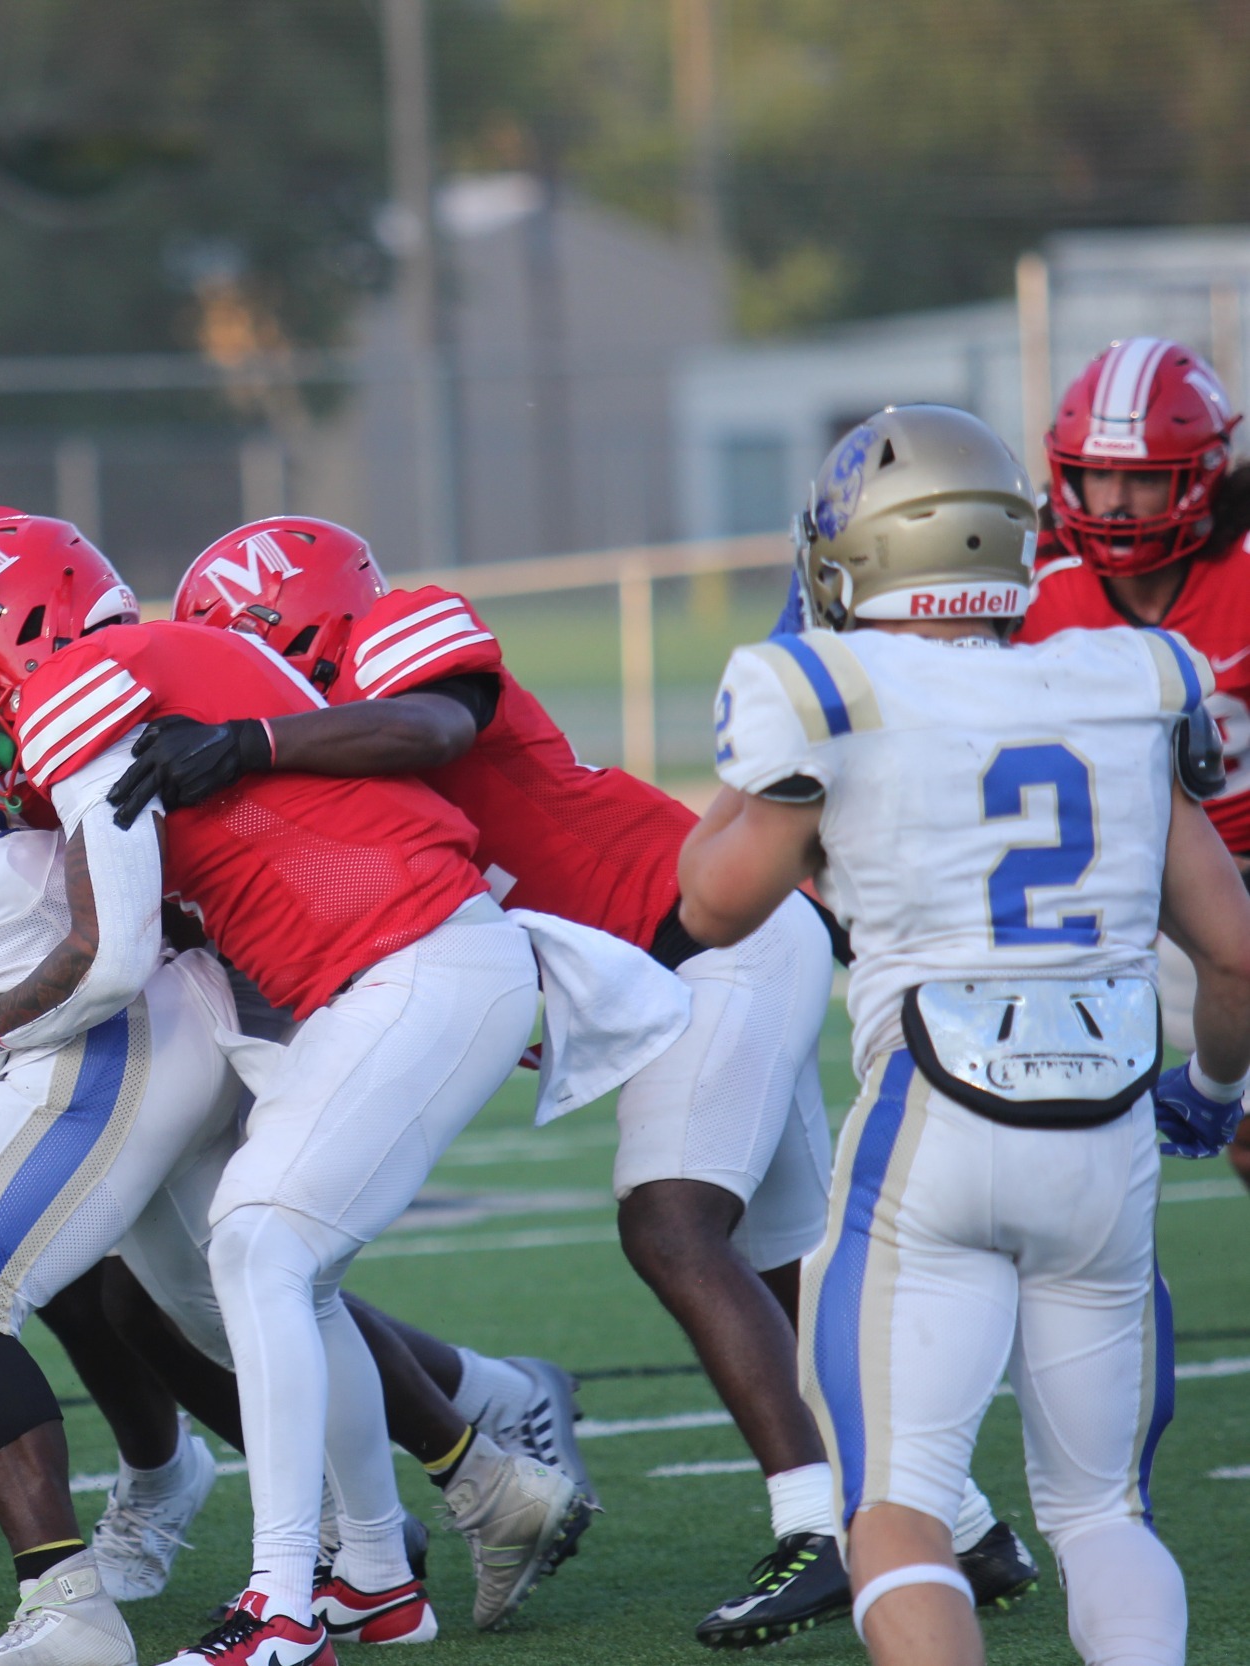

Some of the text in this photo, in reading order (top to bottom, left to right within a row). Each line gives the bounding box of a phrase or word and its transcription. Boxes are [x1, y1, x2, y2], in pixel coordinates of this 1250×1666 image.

[200, 529, 303, 616] M
[910, 590, 1017, 616] Riddell
[979, 738, 1103, 951] 2
